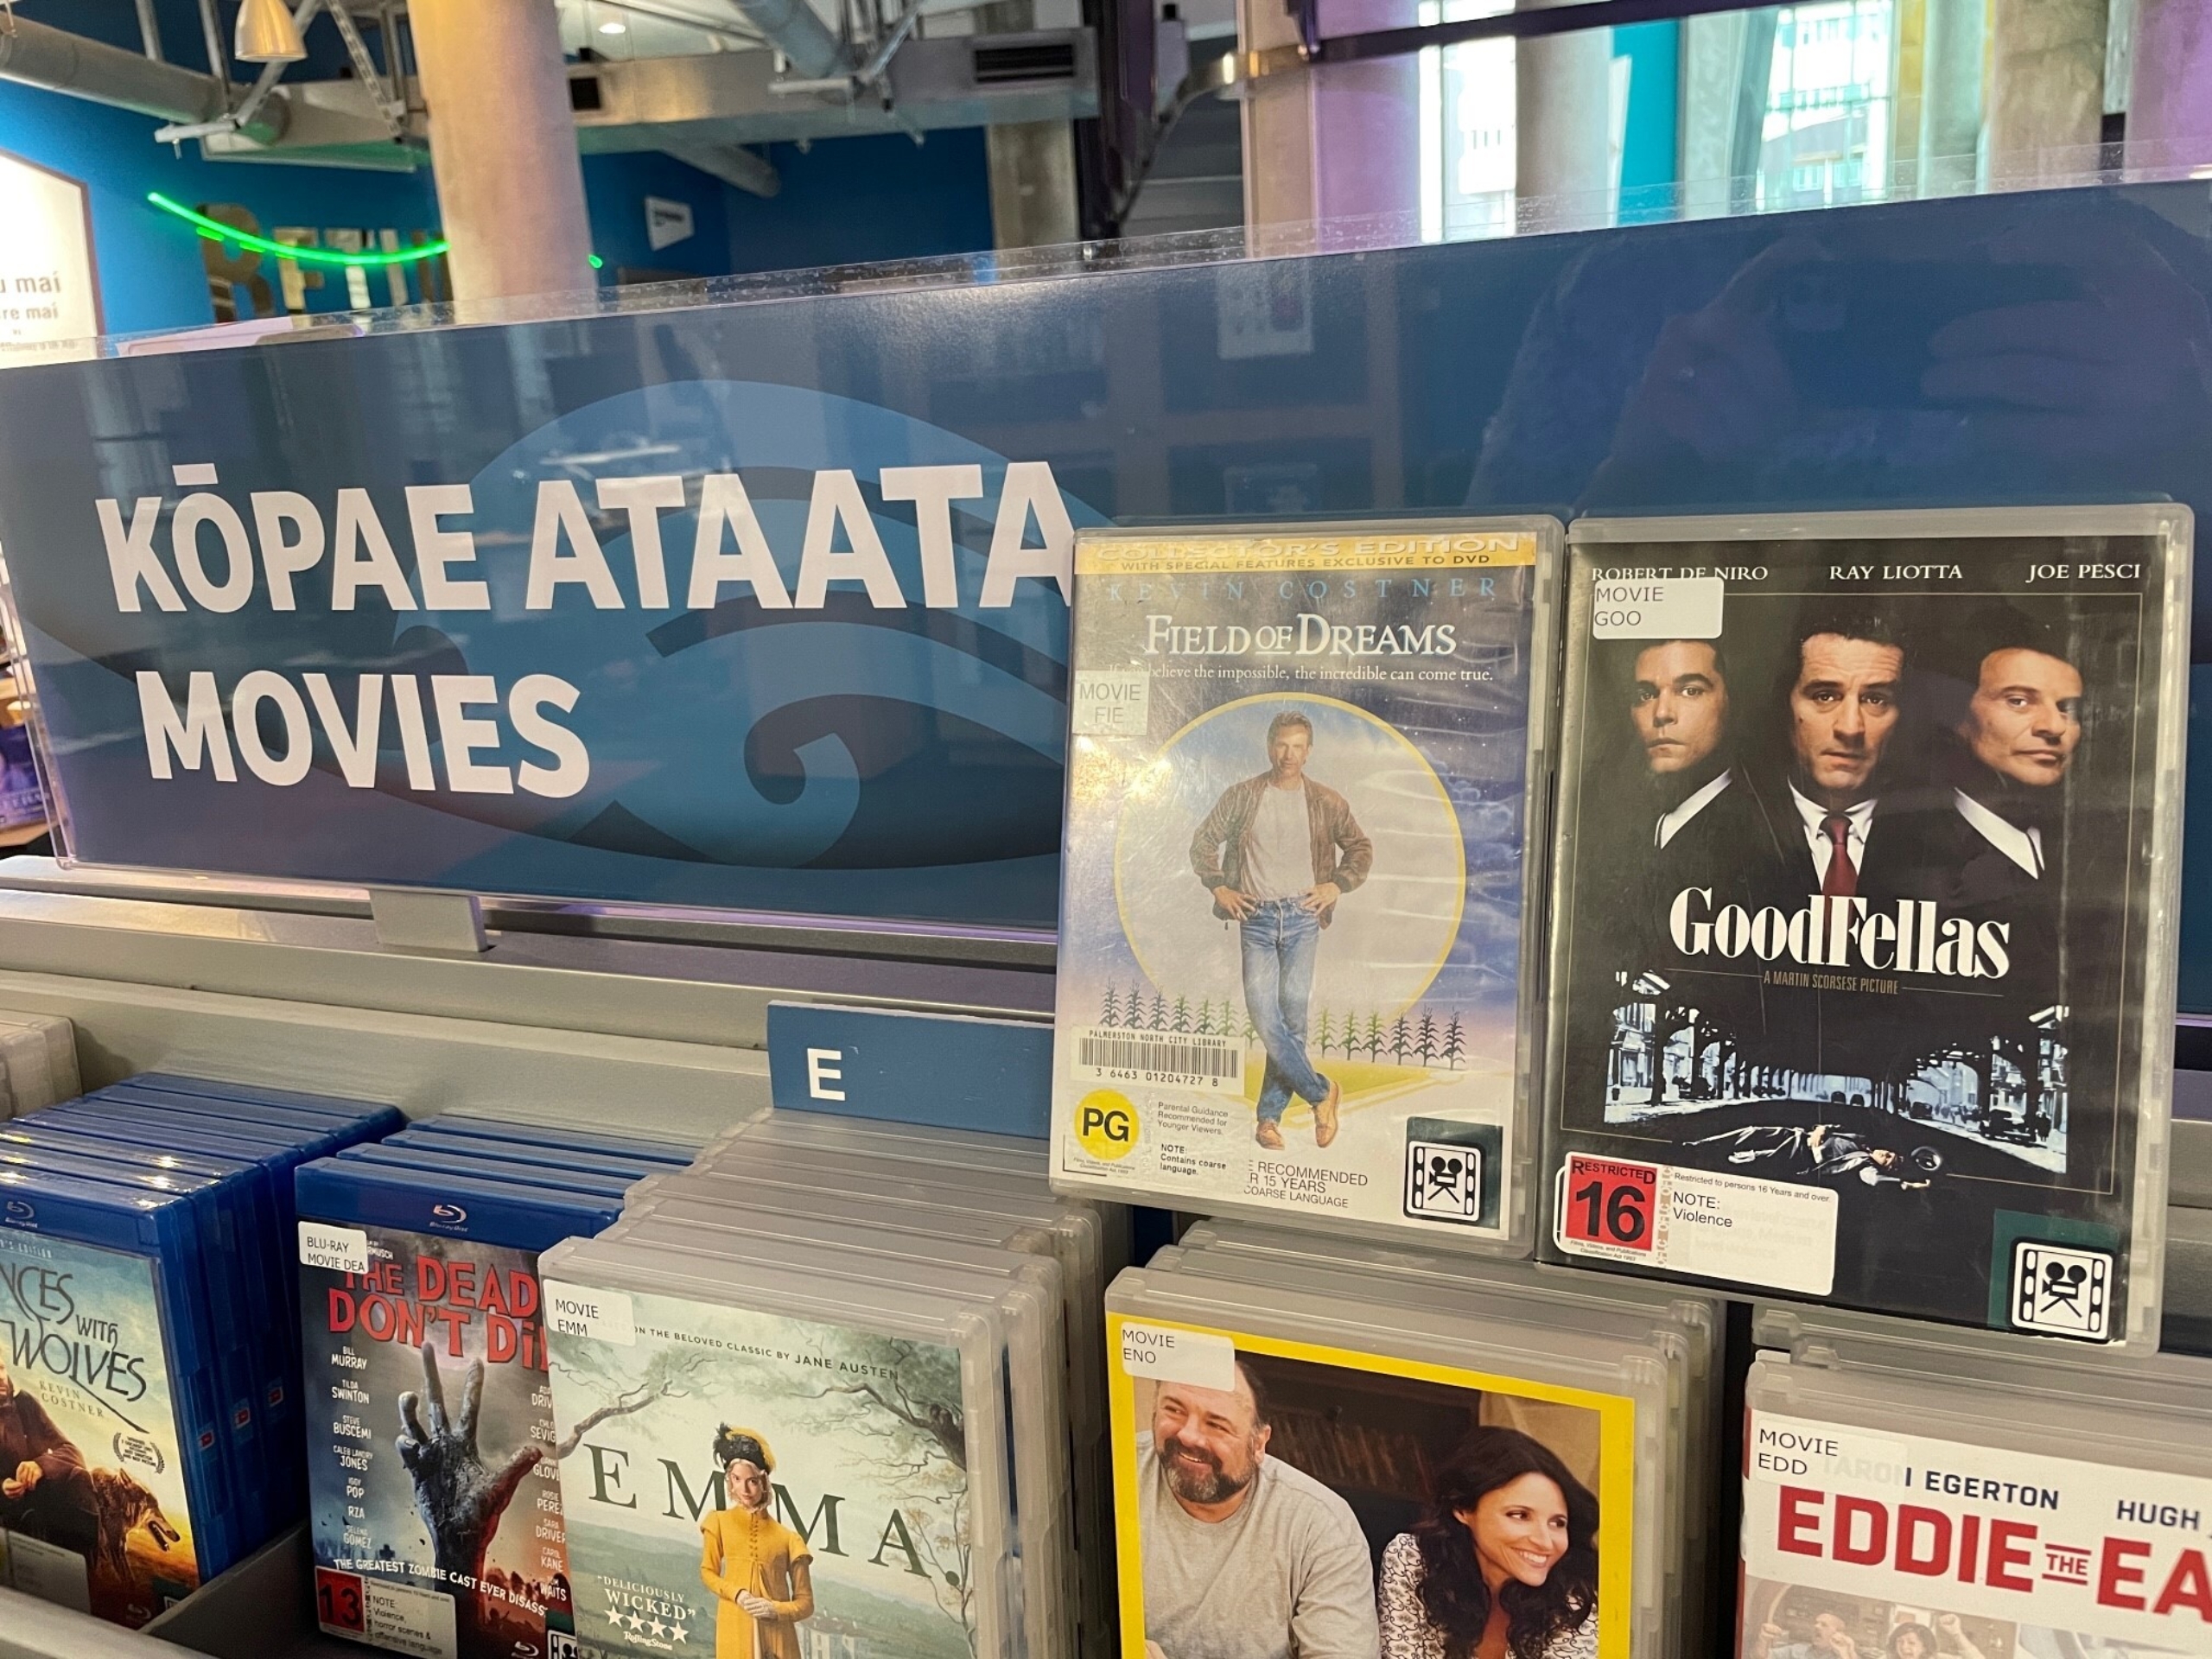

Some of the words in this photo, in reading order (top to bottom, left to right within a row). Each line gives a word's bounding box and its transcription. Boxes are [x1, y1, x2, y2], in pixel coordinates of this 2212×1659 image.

[95, 463, 491, 613] KŌPAE
[525, 461, 1074, 609] ATAATA
[1098, 543, 1340, 562] COLLECTOR'S
[1354, 537, 1519, 556] EDITION
[1122, 562, 1160, 571] WITH
[1166, 560, 1229, 570] SPECIAL
[1236, 559, 1315, 569] FEATURES
[1323, 556, 1414, 567] EXCLUSIVE
[1425, 556, 1446, 564] TO
[1452, 555, 1490, 564] DVD
[1829, 565, 1875, 580] RAY
[1882, 564, 1963, 580] LIOTTA
[1592, 568, 1673, 581] ROBERT
[1680, 567, 1707, 579] DE
[1714, 566, 1769, 581] NIRO
[2025, 564, 2070, 583] JOE
[2077, 563, 2141, 580] PESCI
[1109, 582, 1244, 601] KEVIN
[1280, 578, 1497, 600] COSTNER
[1595, 586, 1664, 602] MOVIE
[1593, 610, 1642, 626] GOO
[1142, 614, 1251, 656] FIELD
[1255, 625, 1294, 650] OF
[1295, 613, 1457, 656] DREAMS
[1148, 664, 1192, 678] believe
[1194, 664, 1214, 678] the
[1217, 664, 1290, 683] impossible,
[1295, 665, 1316, 679] the
[1319, 665, 1387, 680] incredible
[1390, 670, 1414, 680] can
[1418, 670, 1457, 680] come
[1460, 669, 1493, 681] true.
[1078, 683, 1141, 701] MOVIE
[1094, 707, 1124, 723] FIE
[136, 671, 590, 798] MOVIES
[1669, 887, 2011, 979] GoodFellas
[1764, 972, 1770, 983] A
[1773, 972, 1810, 988] MARTIN
[1812, 974, 1857, 991] SCORSESE
[1860, 977, 1899, 995] PICTURE
[1089, 1030, 1135, 1040] PALMERSTON
[1140, 1034, 1164, 1043] NORTH
[1192, 1039, 1226, 1047] LIBRARY
[807, 1048, 846, 1101] E
[1096, 1068, 1103, 1077] 3
[1109, 1069, 1138, 1079] 6463
[1146, 1072, 1204, 1085] 01204727
[1211, 1077, 1218, 1086] 8
[1157, 1111, 1214, 1126] Recommended
[1217, 1118, 1227, 1127] for
[1158, 1102, 1190, 1112] Parental
[1192, 1105, 1229, 1117] Guidance
[1082, 1107, 1129, 1141] PG
[1157, 1120, 1189, 1132] Younger
[1191, 1123, 1224, 1135] Viewers.
[1160, 1143, 1188, 1154] NOTE:
[1160, 1154, 1196, 1166] Contains
[1198, 1160, 1227, 1170] coarse
[1160, 1163, 1199, 1175] language.
[1258, 1161, 1369, 1185] RECOMMENDED
[1571, 1160, 1656, 1185] RESTRICTED
[1263, 1175, 1276, 1187] 15
[1281, 1178, 1326, 1193] YEARS
[1674, 1173, 1713, 1185] Restricted
[1715, 1179, 1723, 1187] to
[1724, 1181, 1757, 1192] persons
[1758, 1184, 1768, 1193] 16
[1770, 1186, 1792, 1198] Years
[1794, 1189, 1809, 1199] and
[1811, 1194, 1831, 1203] over.
[1243, 1185, 1287, 1199] COARSE
[1289, 1192, 1349, 1208] LANGUAGE
[1674, 1191, 1720, 1210] NOTE:
[1575, 1180, 1645, 1243] 16
[1673, 1208, 1733, 1228] Violence
[307, 1236, 349, 1253] BLU-RAY
[308, 1253, 340, 1268] MOVIE
[344, 1259, 365, 1273] DEA
[416, 1255, 539, 1319] DEAD
[556, 1299, 600, 1319] MOVIE
[328, 1288, 471, 1357] DON'T
[557, 1319, 588, 1337] EMM
[1122, 1329, 1175, 1349] MOVIE
[342, 1345, 355, 1355] BILL
[650, 1328, 670, 1338] THE
[674, 1332, 722, 1348] BELOVED
[727, 1342, 772, 1357] CLASSIC
[776, 1351, 790, 1360] BY
[794, 1354, 833, 1369] JANE
[839, 1362, 899, 1381] AUSTEN
[1123, 1347, 1156, 1363] ENO
[0, 1319, 147, 1402] WOLVES
[331, 1353, 367, 1370] MURRAY
[39, 1381, 81, 1400] KEVIN
[341, 1379, 359, 1389] TILDA
[331, 1386, 370, 1404] SWINTON
[41, 1393, 105, 1417] COSTNER
[342, 1414, 360, 1426] STEVE
[333, 1421, 372, 1440] BUSCEMI
[531, 1426, 556, 1443] SEVIG
[333, 1445, 351, 1456] CALEB
[1759, 1428, 1839, 1457] MOVIE
[340, 1455, 368, 1471] JONES
[1758, 1452, 1808, 1475] EDD
[346, 1485, 365, 1499] POP
[1924, 1471, 2059, 1510] EGERTON
[2116, 1499, 2201, 1531] HUGH
[347, 1505, 365, 1519] RZA
[343, 1532, 372, 1549] GOMEZ
[1777, 1485, 2038, 1593] EDDIE
[2045, 1553, 2089, 1576] THE
[540, 1555, 563, 1573] KANE
[334, 1559, 354, 1570] THE
[355, 1559, 405, 1573] GREATEST
[408, 1563, 447, 1580] ZOMBIE
[449, 1572, 478, 1590] CAST
[480, 1581, 506, 1600] EVER
[540, 1582, 567, 1601] WAITS
[319, 1584, 361, 1626] 13
